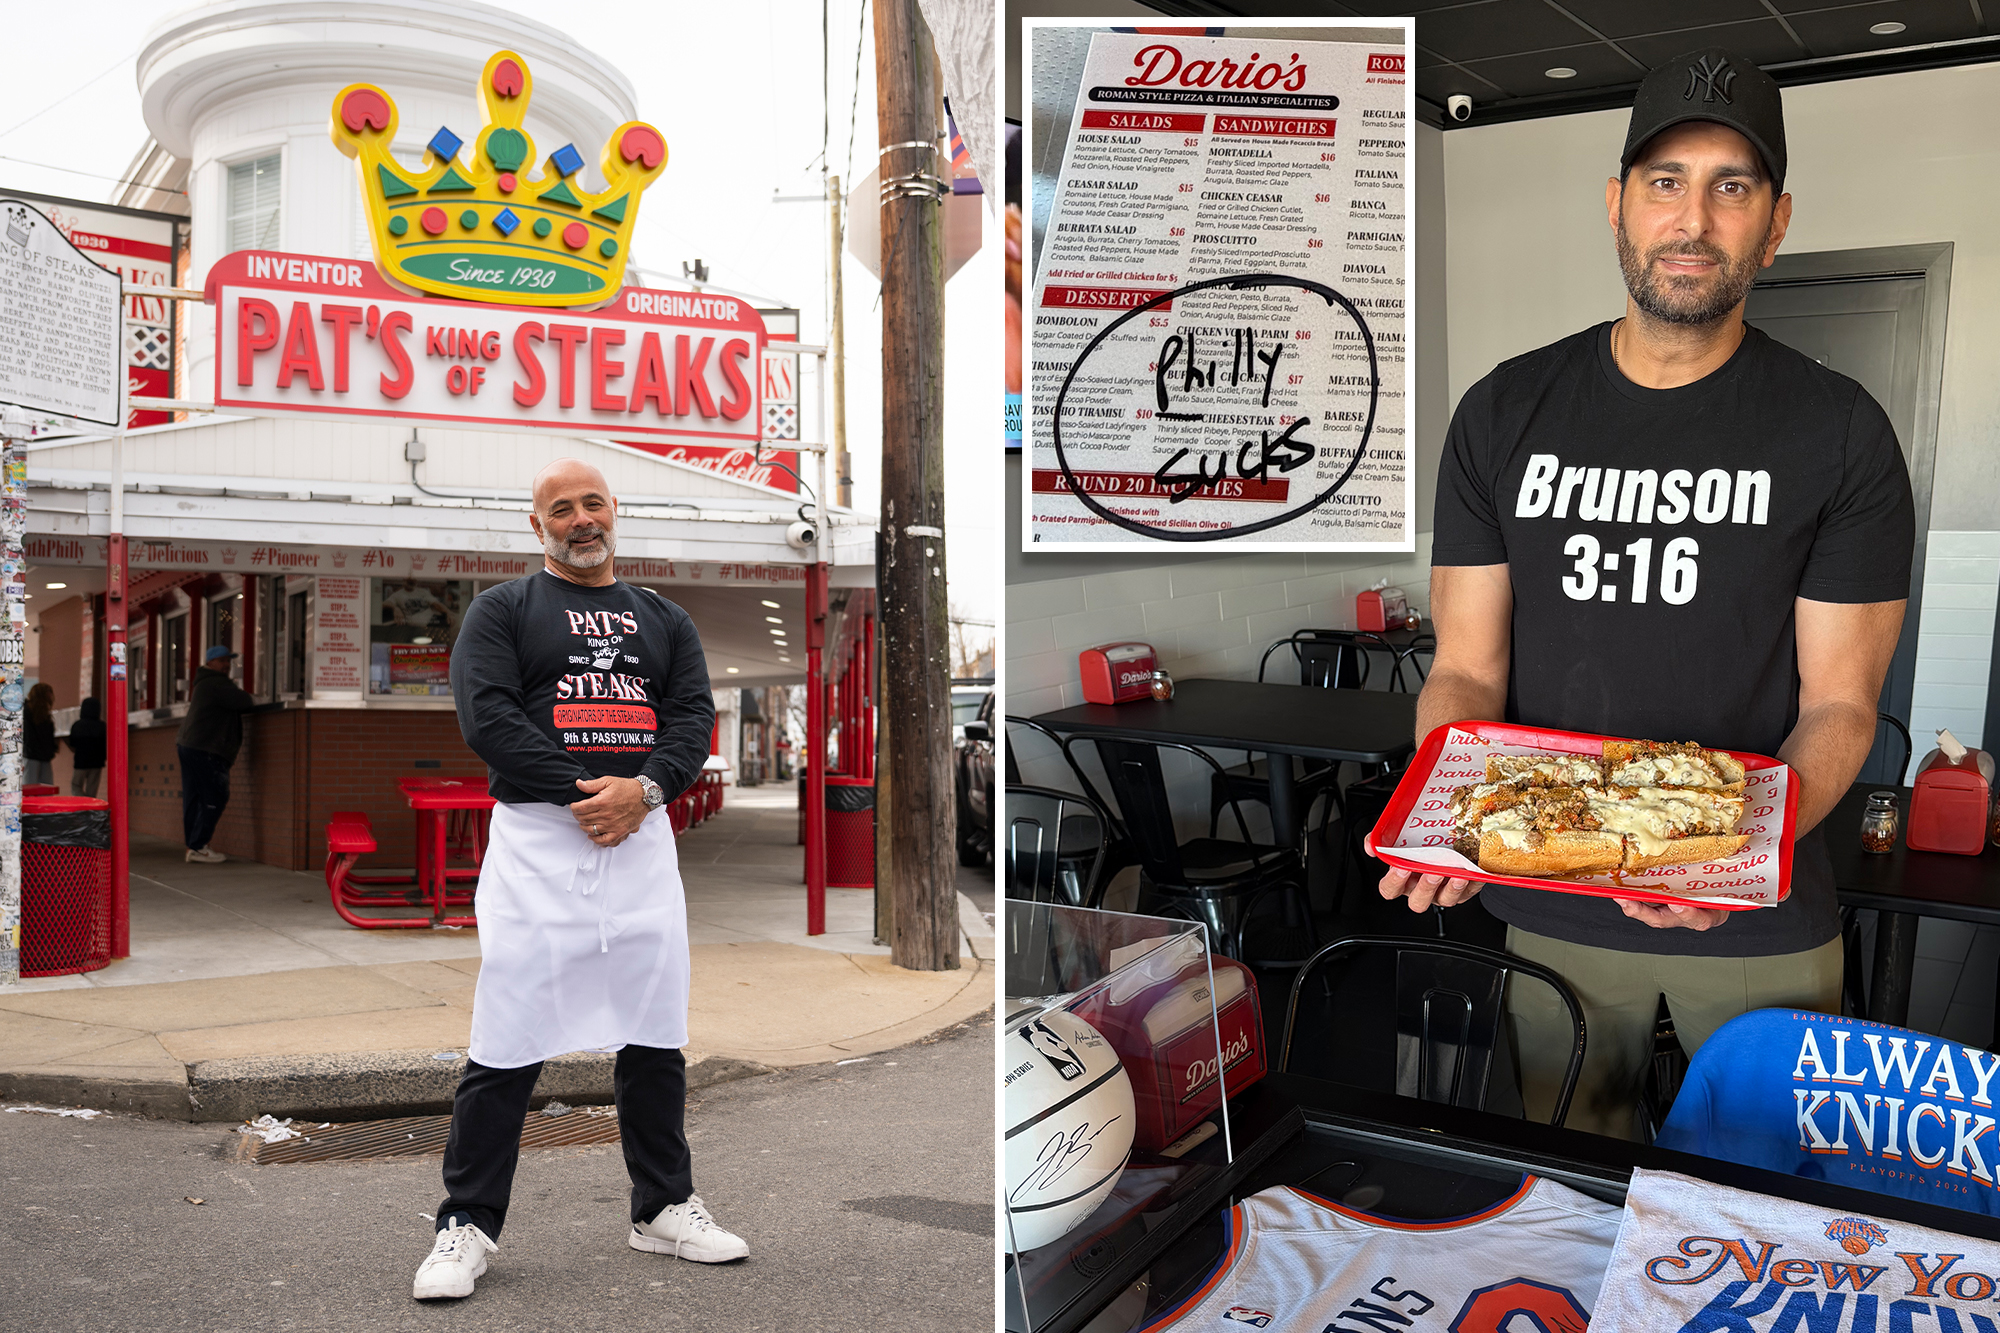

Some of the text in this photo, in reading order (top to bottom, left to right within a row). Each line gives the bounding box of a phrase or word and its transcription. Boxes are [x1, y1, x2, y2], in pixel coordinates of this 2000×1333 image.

[1125, 44, 1307, 92] Dario's
[1684, 55, 1737, 104] NY
[1097, 90, 1331, 107] ROMAN STYLE PIZZA & ITALIAN SPECIALITIES
[1109, 114, 1173, 128] SALADS
[1219, 119, 1328, 135] SANDWICHES
[1077, 134, 1198, 147] HOUSE SALAD $15
[1075, 145, 1107, 153] Romaine
[1138, 147, 1162, 156] Cherry
[1164, 148, 1200, 157] Tomatoes,
[1209, 148, 1336, 162] MORTADELLA $16
[1355, 169, 1398, 179] ITALIANA
[1067, 179, 1194, 193] CEASAR SALAD $15
[1200, 191, 1330, 203] CHICKEN CEASAR $16
[1351, 200, 1386, 210] BIANCA
[1057, 223, 1186, 237] BURRATA SALAD $16
[73, 236, 109, 249] 1930
[1307, 238, 1323, 249] $16
[23, 249, 41, 263] OF
[247, 255, 362, 287] INVENTOR
[447, 258, 557, 289] Since 1930
[1046, 269, 1062, 278] Add
[1064, 270, 1084, 279] Fried
[1095, 271, 1122, 280] Grilled
[1123, 272, 1155, 281] Chicken
[1156, 273, 1168, 282] for
[1169, 274, 1178, 283] $5
[1343, 264, 1386, 275] DIAVOLA
[1065, 290, 1151, 306] DESSERTS
[626, 292, 739, 323] ORIGINATOR
[1036, 316, 1169, 328] BOMBOLONI $5.5
[1261, 328, 1311, 340] PARM $16
[1377, 332, 1400, 342] HAM
[237, 297, 415, 400] PAT'S
[427, 325, 501, 360] KING
[513, 320, 751, 422] STEAKS
[447, 365, 486, 396] OF
[1288, 374, 1304, 385] $17
[1078, 408, 1125, 418] TIRAMISU
[1136, 409, 1152, 419] $10
[1324, 411, 1365, 422] BARESE
[1125, 478, 1145, 493] 20
[1515, 454, 1771, 525] Brunson
[130, 542, 209, 564] #Delicious
[251, 547, 320, 568] #Pioneer
[362, 550, 395, 568] #Yo
[437, 555, 528, 575] #TheInventor
[1562, 534, 1699, 605] 3:16
[565, 609, 638, 637] PAT'S
[588, 636, 624, 647] KING OF
[568, 655, 639, 665] SINCE 1930
[1121, 670, 1151, 685] Dario's
[558, 709, 596, 723] ORIGINATORS
[597, 709, 605, 723] OF
[605, 710, 617, 723] THE
[617, 710, 634, 724] STEAK
[563, 732, 579, 744] 9th
[582, 732, 589, 744] &
[592, 732, 642, 744] PASSYUNK
[1686, 875, 1767, 891] Dario's
[1793, 1013, 1853, 1025] EASTERN
[1013, 1061, 1035, 1078] SERIES
[1060, 1062, 1079, 1079] NBA
[1793, 1089, 2000, 1191] KNICK
[1850, 1163, 1969, 1195] PLAYOFFS 2026
[1824, 1219, 1887, 1243] KNICKS
[1645, 1236, 1889, 1292] New
